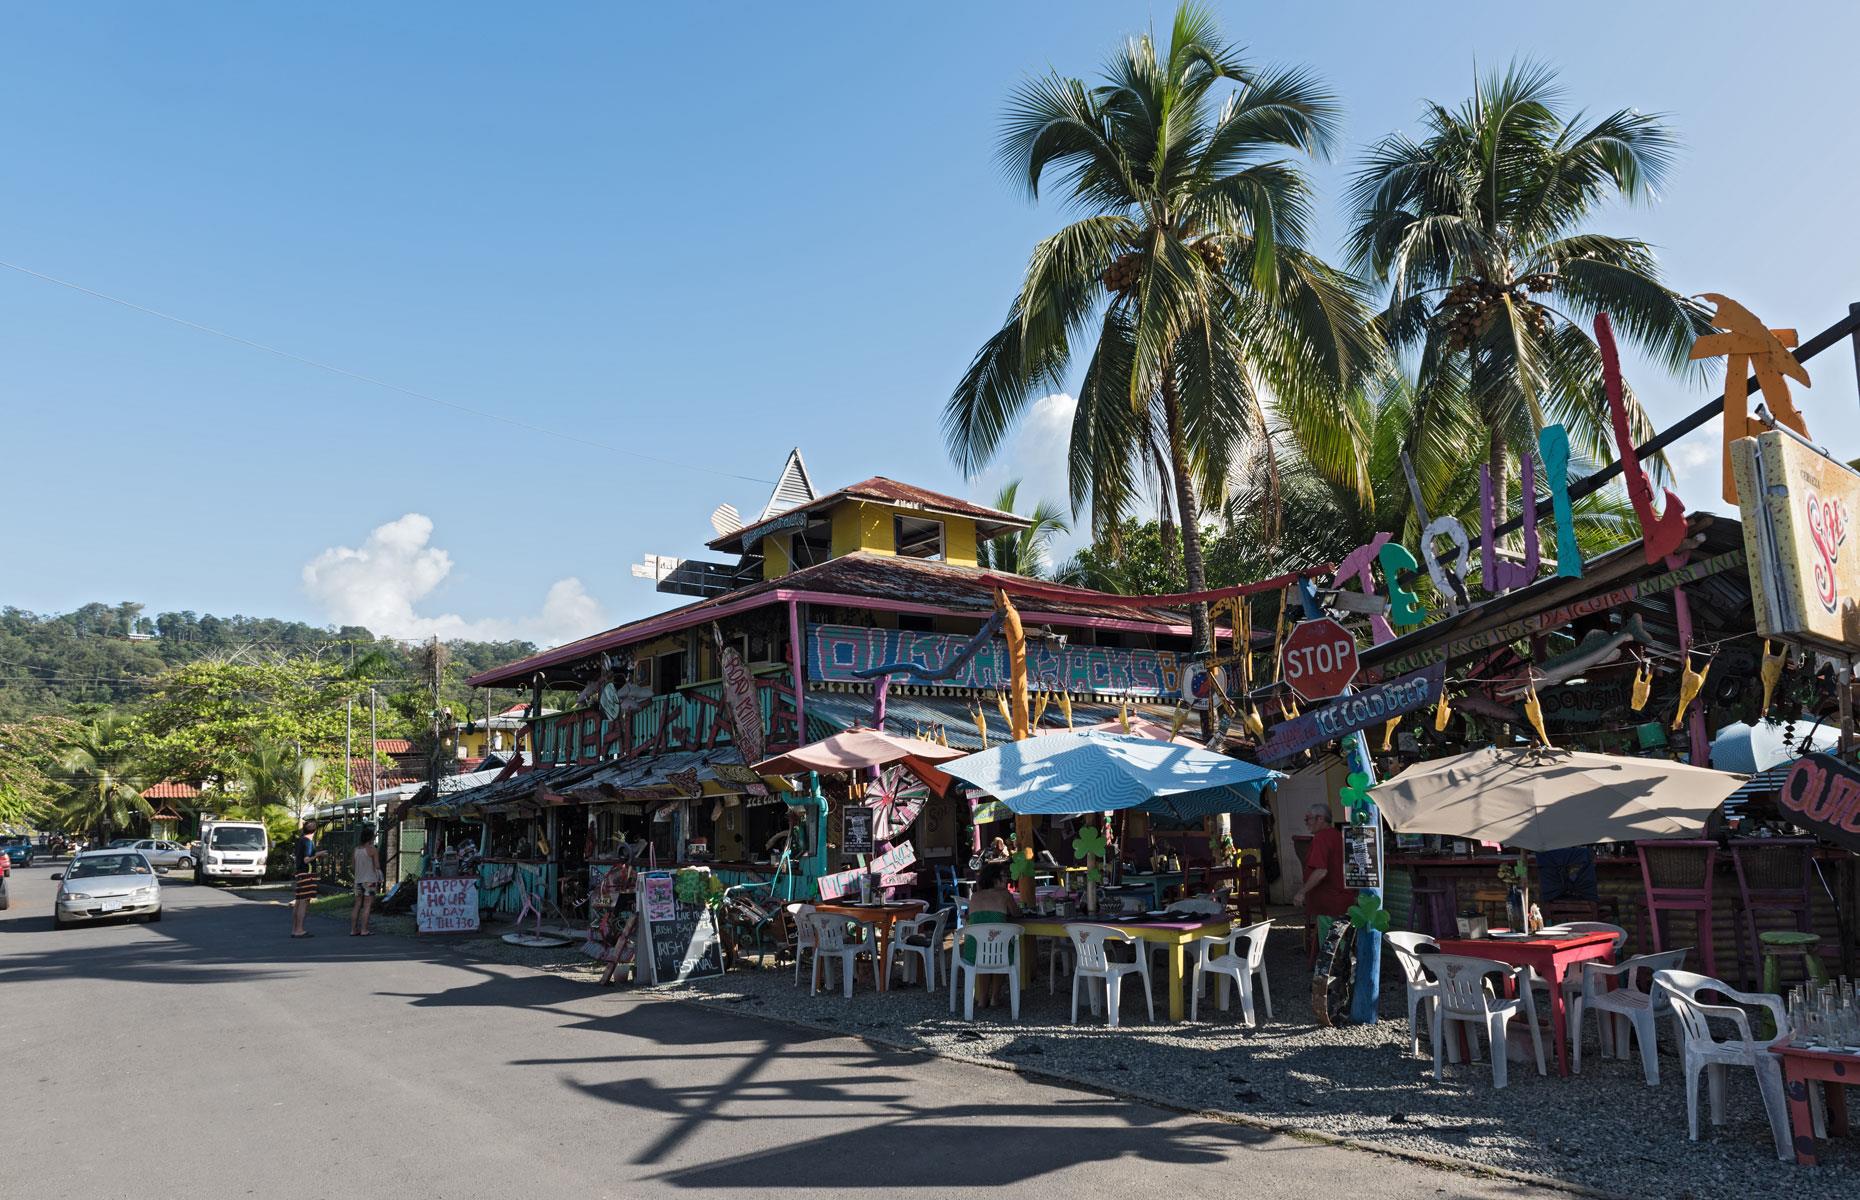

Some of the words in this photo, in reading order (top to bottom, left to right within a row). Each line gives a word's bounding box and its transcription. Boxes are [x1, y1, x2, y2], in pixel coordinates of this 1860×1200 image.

[1800, 469, 1820, 490] CERVEZA
[1288, 640, 1350, 678] STOP
[725, 657, 750, 695] ROAD
[1315, 705, 1344, 737] ICE
[1341, 693, 1385, 726] COLD
[1382, 677, 1429, 711] BEER
[747, 797, 762, 808] ICE
[420, 880, 468, 895] HAPPY
[427, 892, 466, 907] HOUR
[420, 908, 435, 918] ALL
[443, 907, 464, 917] DAY
[676, 911, 691, 920] LIVE
[436, 917, 454, 929] TILL
